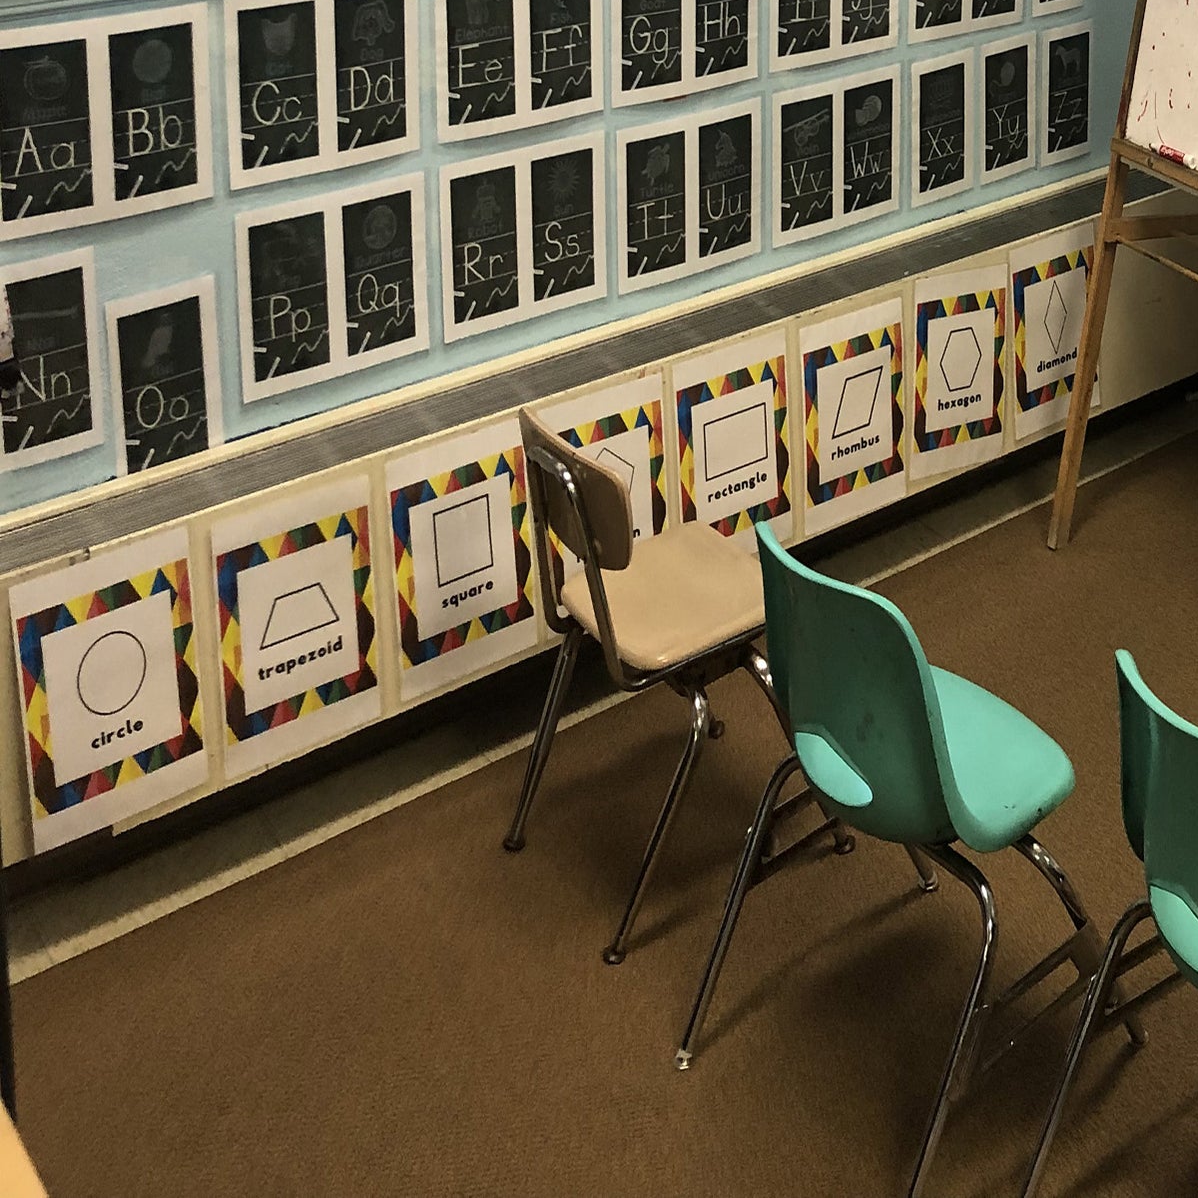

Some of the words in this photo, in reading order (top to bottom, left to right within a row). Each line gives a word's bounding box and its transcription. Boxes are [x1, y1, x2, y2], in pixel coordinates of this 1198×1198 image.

[1036, 347, 1078, 374] diamond
[937, 392, 982, 412] hexagon
[831, 434, 880, 461] rhombus
[707, 471, 768, 504] rectangle
[441, 580, 495, 610] square
[257, 636, 344, 682] trapezoid
[90, 717, 144, 751] circle
